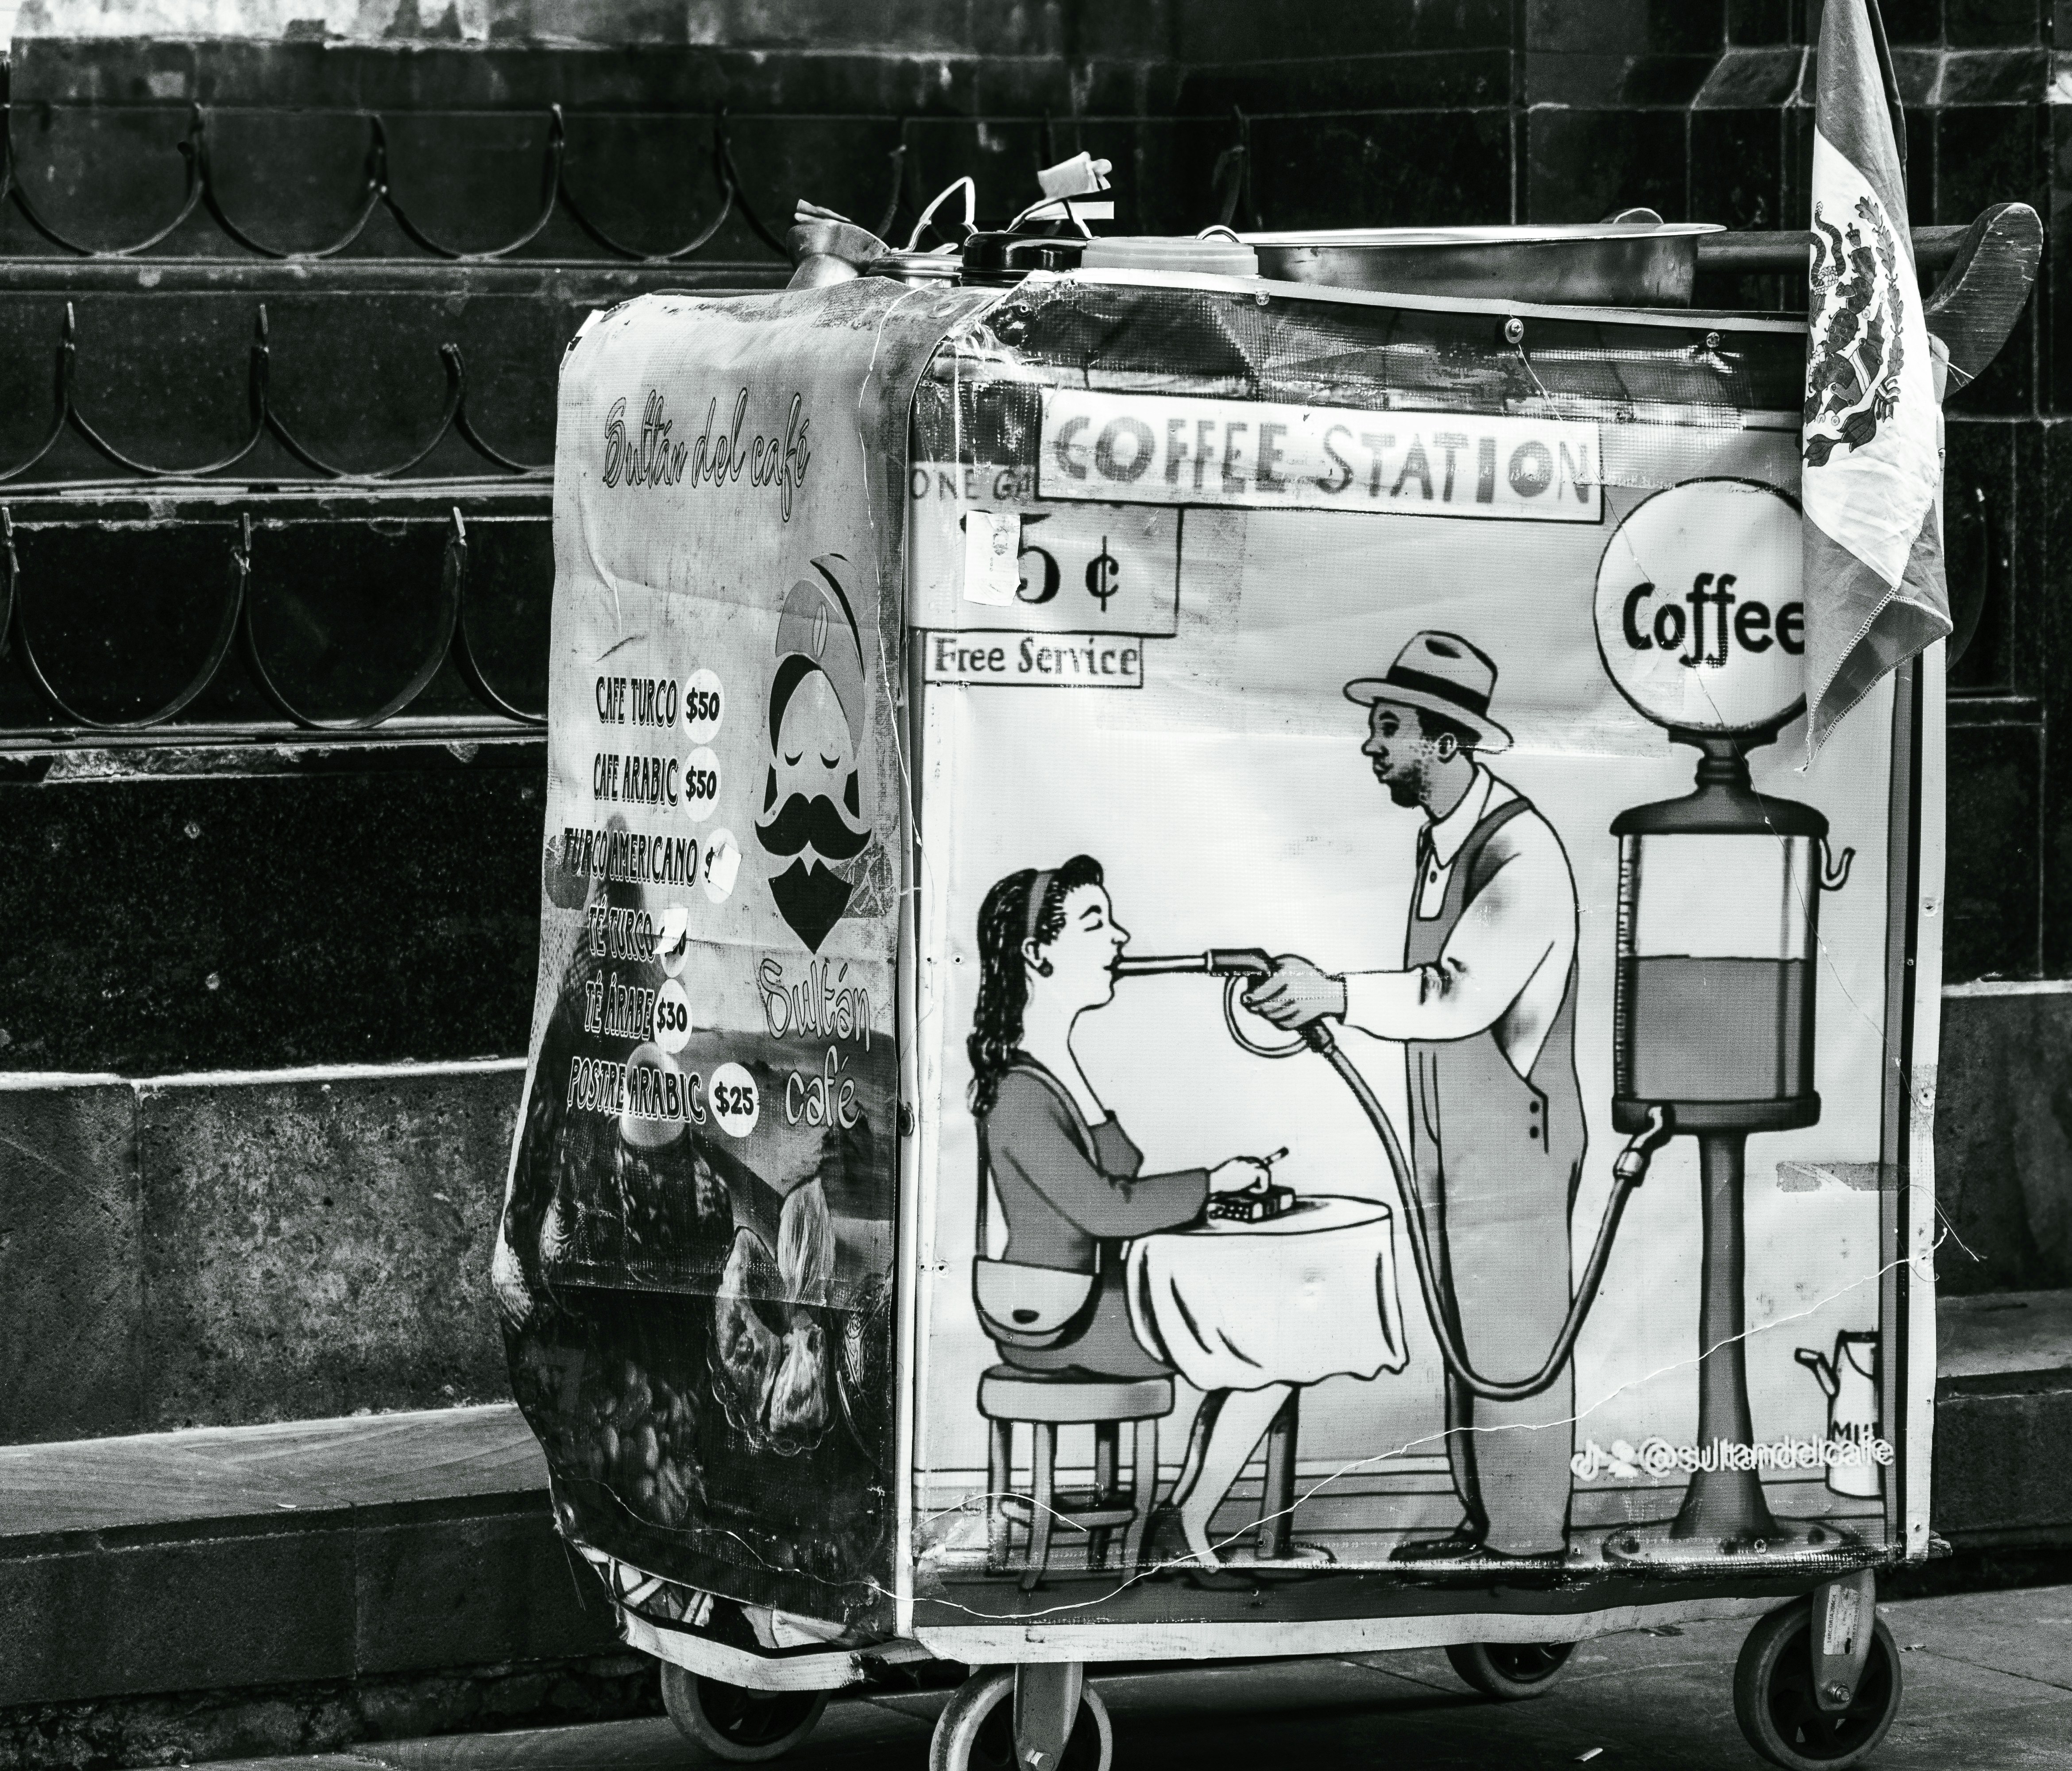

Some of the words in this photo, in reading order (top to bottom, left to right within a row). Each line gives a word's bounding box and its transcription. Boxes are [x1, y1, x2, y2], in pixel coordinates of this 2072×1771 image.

[603, 389, 688, 489] Sultán
[691, 387, 748, 489] del
[751, 392, 811, 522] café
[909, 468, 980, 500] ONE
[1055, 416, 1287, 495] COFFEE
[1316, 424, 1590, 504] STATION
[1623, 572, 1805, 669] Coffee
[934, 638, 1005, 672] Free
[1018, 636, 1138, 675] Service
[595, 676, 626, 724] CAFE
[631, 678, 678, 728] TURCO
[686, 687, 720, 723] $50
[593, 753, 619, 801] CAFE
[622, 755, 680, 807] ARABIC
[685, 766, 717, 801] $50
[564, 827, 607, 878] TURCO
[610, 831, 699, 888] AMERICANO
[588, 894, 607, 956] TÉ
[608, 907, 656, 963] TURCO
[585, 970, 603, 1033] TÉ
[604, 973, 655, 1042] ÁRABE
[657, 998, 688, 1036] $30
[759, 958, 870, 1052] Sultán
[567, 1056, 626, 1115] POSTRE
[628, 1064, 706, 1125] ARABIC
[714, 1081, 755, 1117] $25
